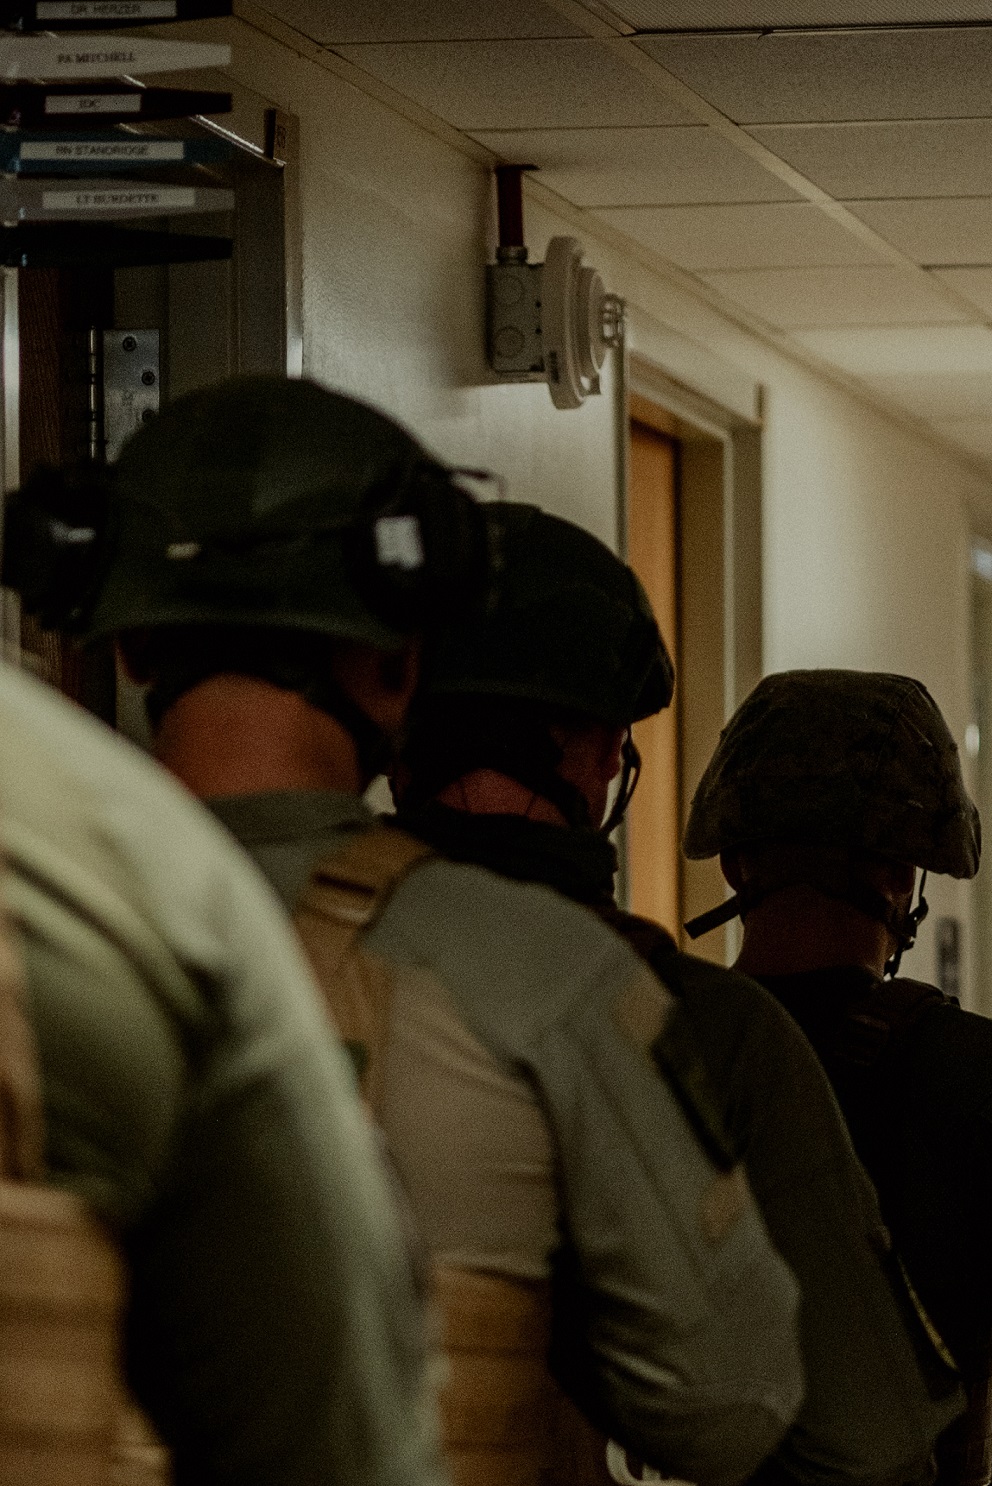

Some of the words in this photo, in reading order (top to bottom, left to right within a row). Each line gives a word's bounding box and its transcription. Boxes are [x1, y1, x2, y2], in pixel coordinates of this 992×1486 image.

[72, 4, 87, 14] DR
[57, 53, 72, 64] PA
[76, 51, 135, 63] MITCHELL
[55, 145, 72, 155] RN
[75, 144, 150, 156] STANDRIDGE
[75, 193, 89, 205] LT
